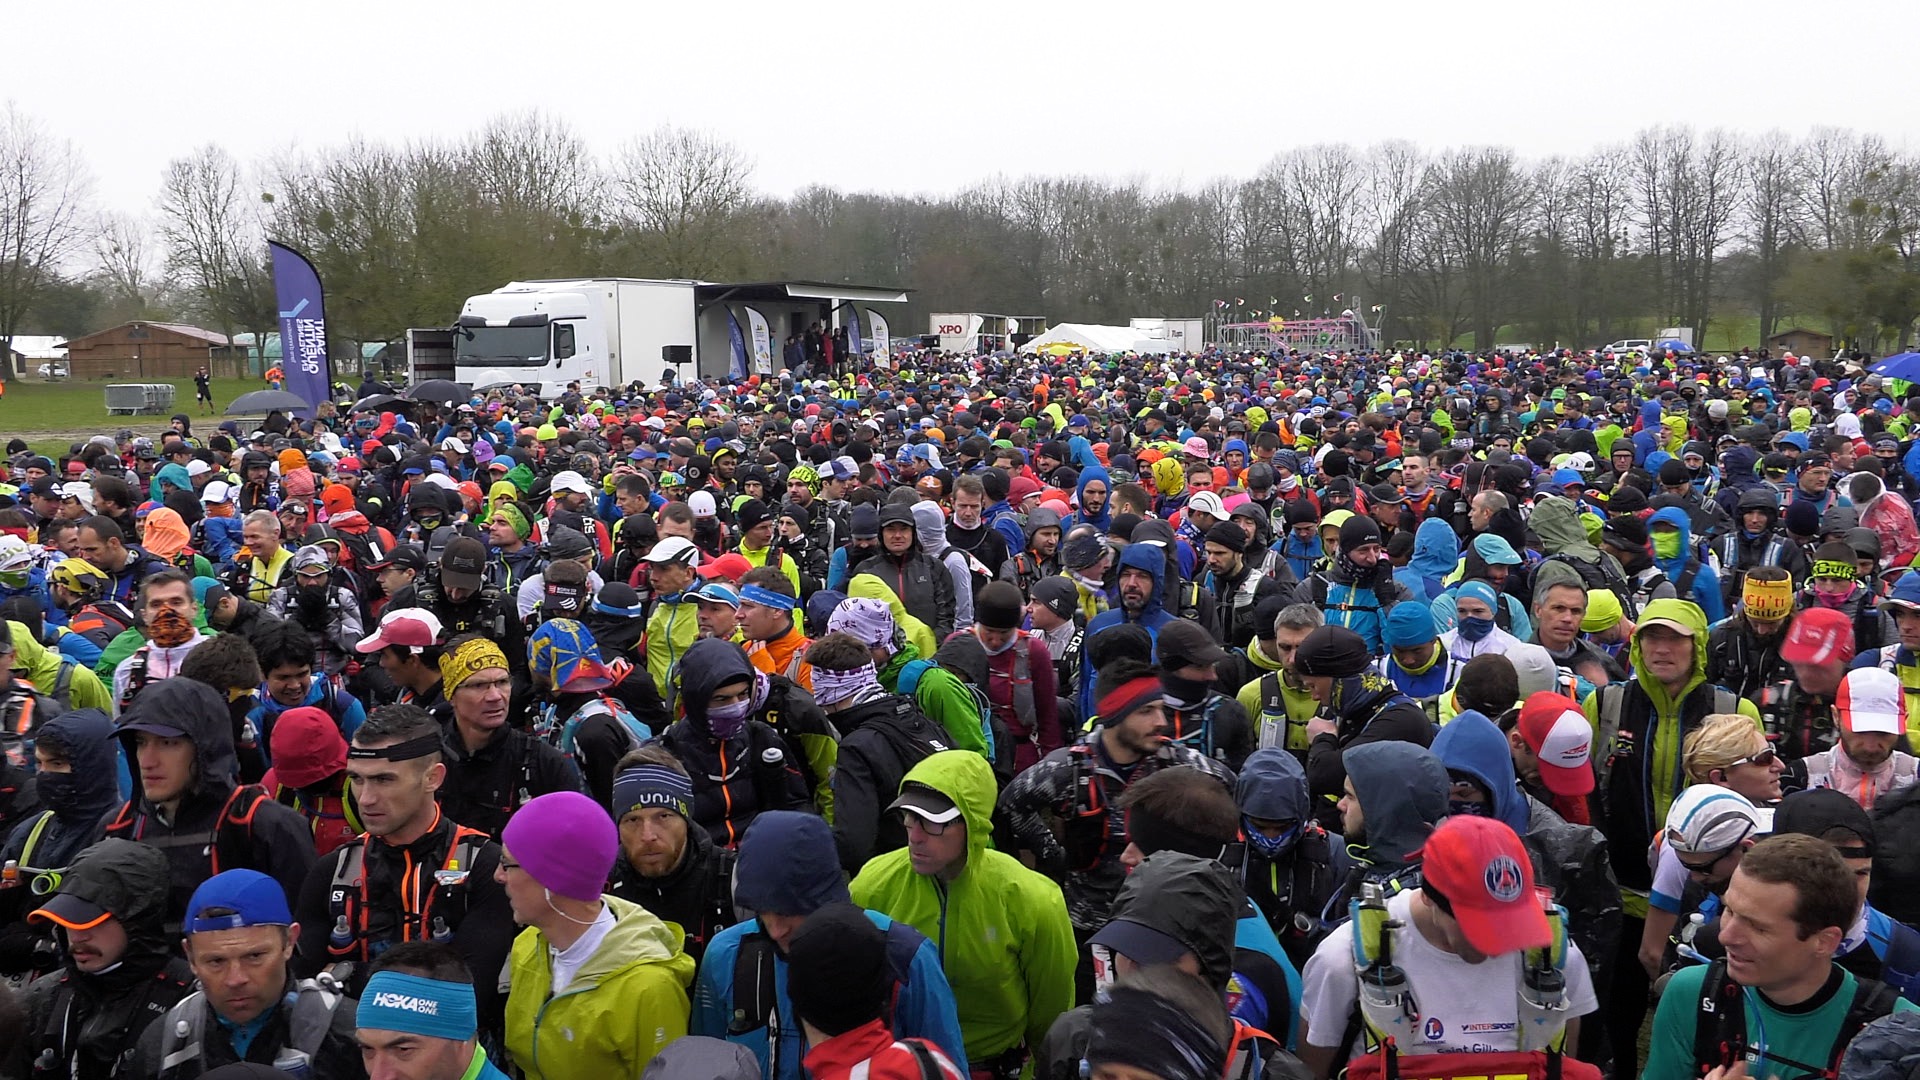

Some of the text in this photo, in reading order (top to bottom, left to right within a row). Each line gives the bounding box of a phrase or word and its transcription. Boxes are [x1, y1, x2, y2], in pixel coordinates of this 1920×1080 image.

[939, 325, 962, 334] XPO
[1746, 594, 1785, 608] Ch'ti
[373, 992, 439, 1012] HOKA ONE
[418, 1007, 438, 1016] ONE
[1469, 1022, 1516, 1031] INTERSPORT
